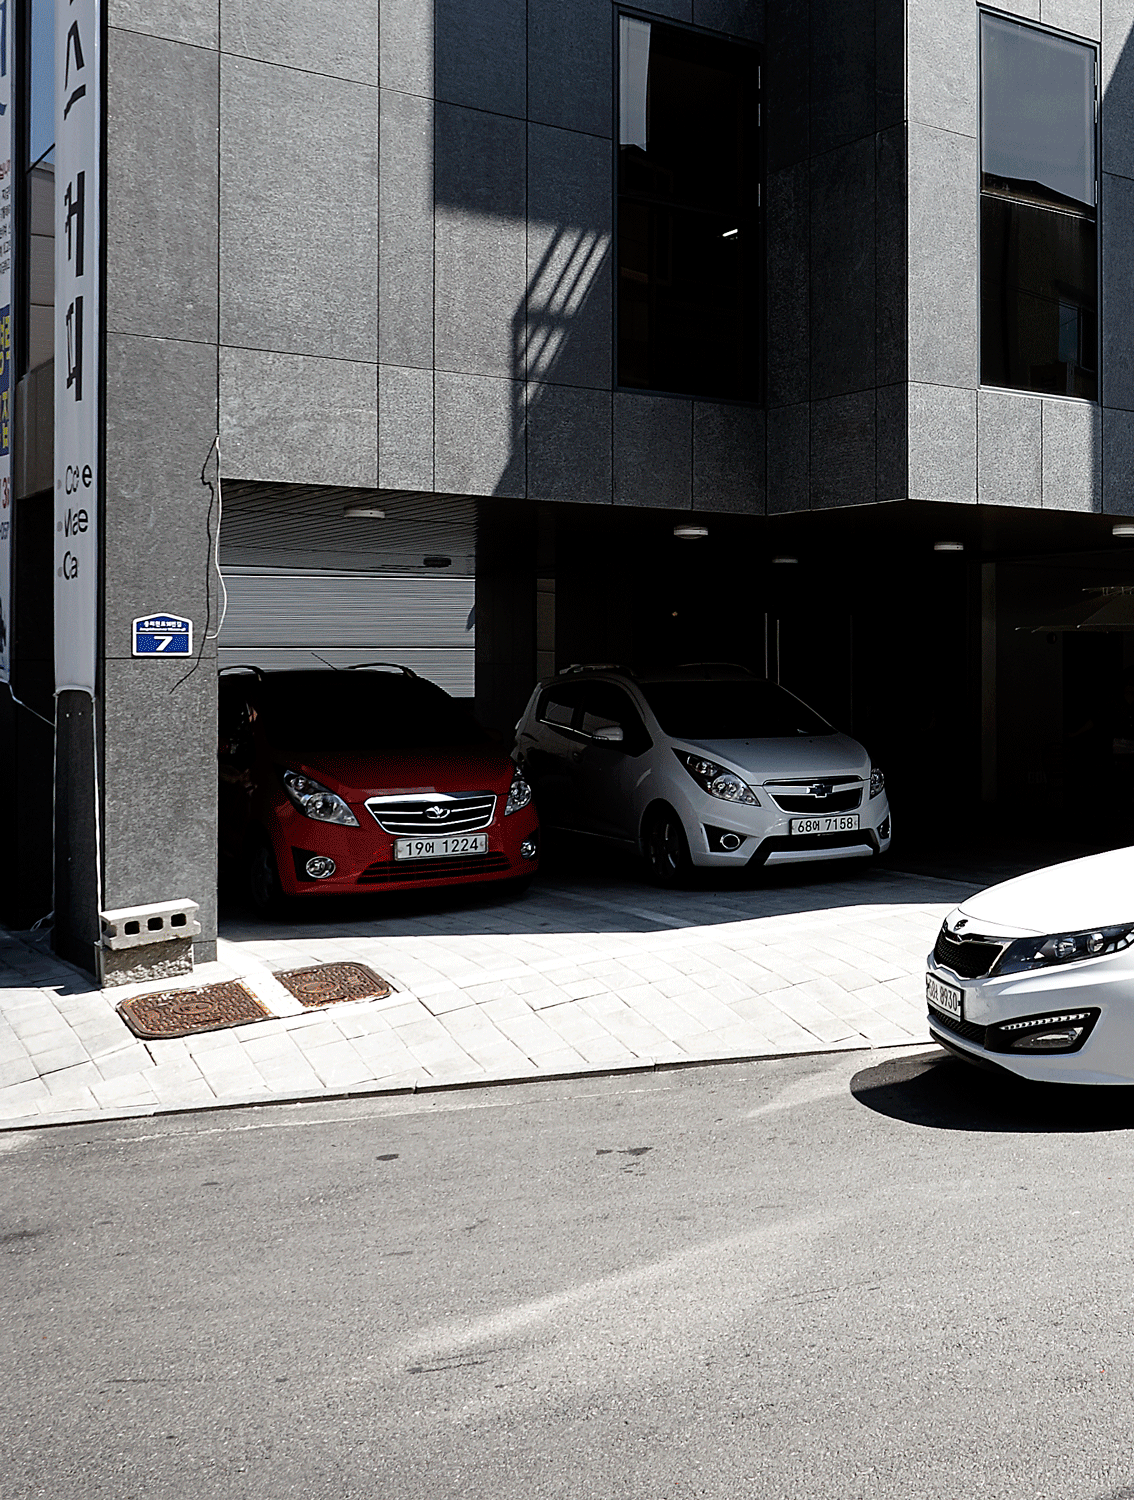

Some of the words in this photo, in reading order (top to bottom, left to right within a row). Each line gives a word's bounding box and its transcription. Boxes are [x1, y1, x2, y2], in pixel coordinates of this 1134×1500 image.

[153, 635, 173, 651] 7
[798, 820, 820, 832] 68어
[825, 817, 853, 830] 7158
[406, 842, 434, 856] 19어
[442, 838, 478, 853] 1224
